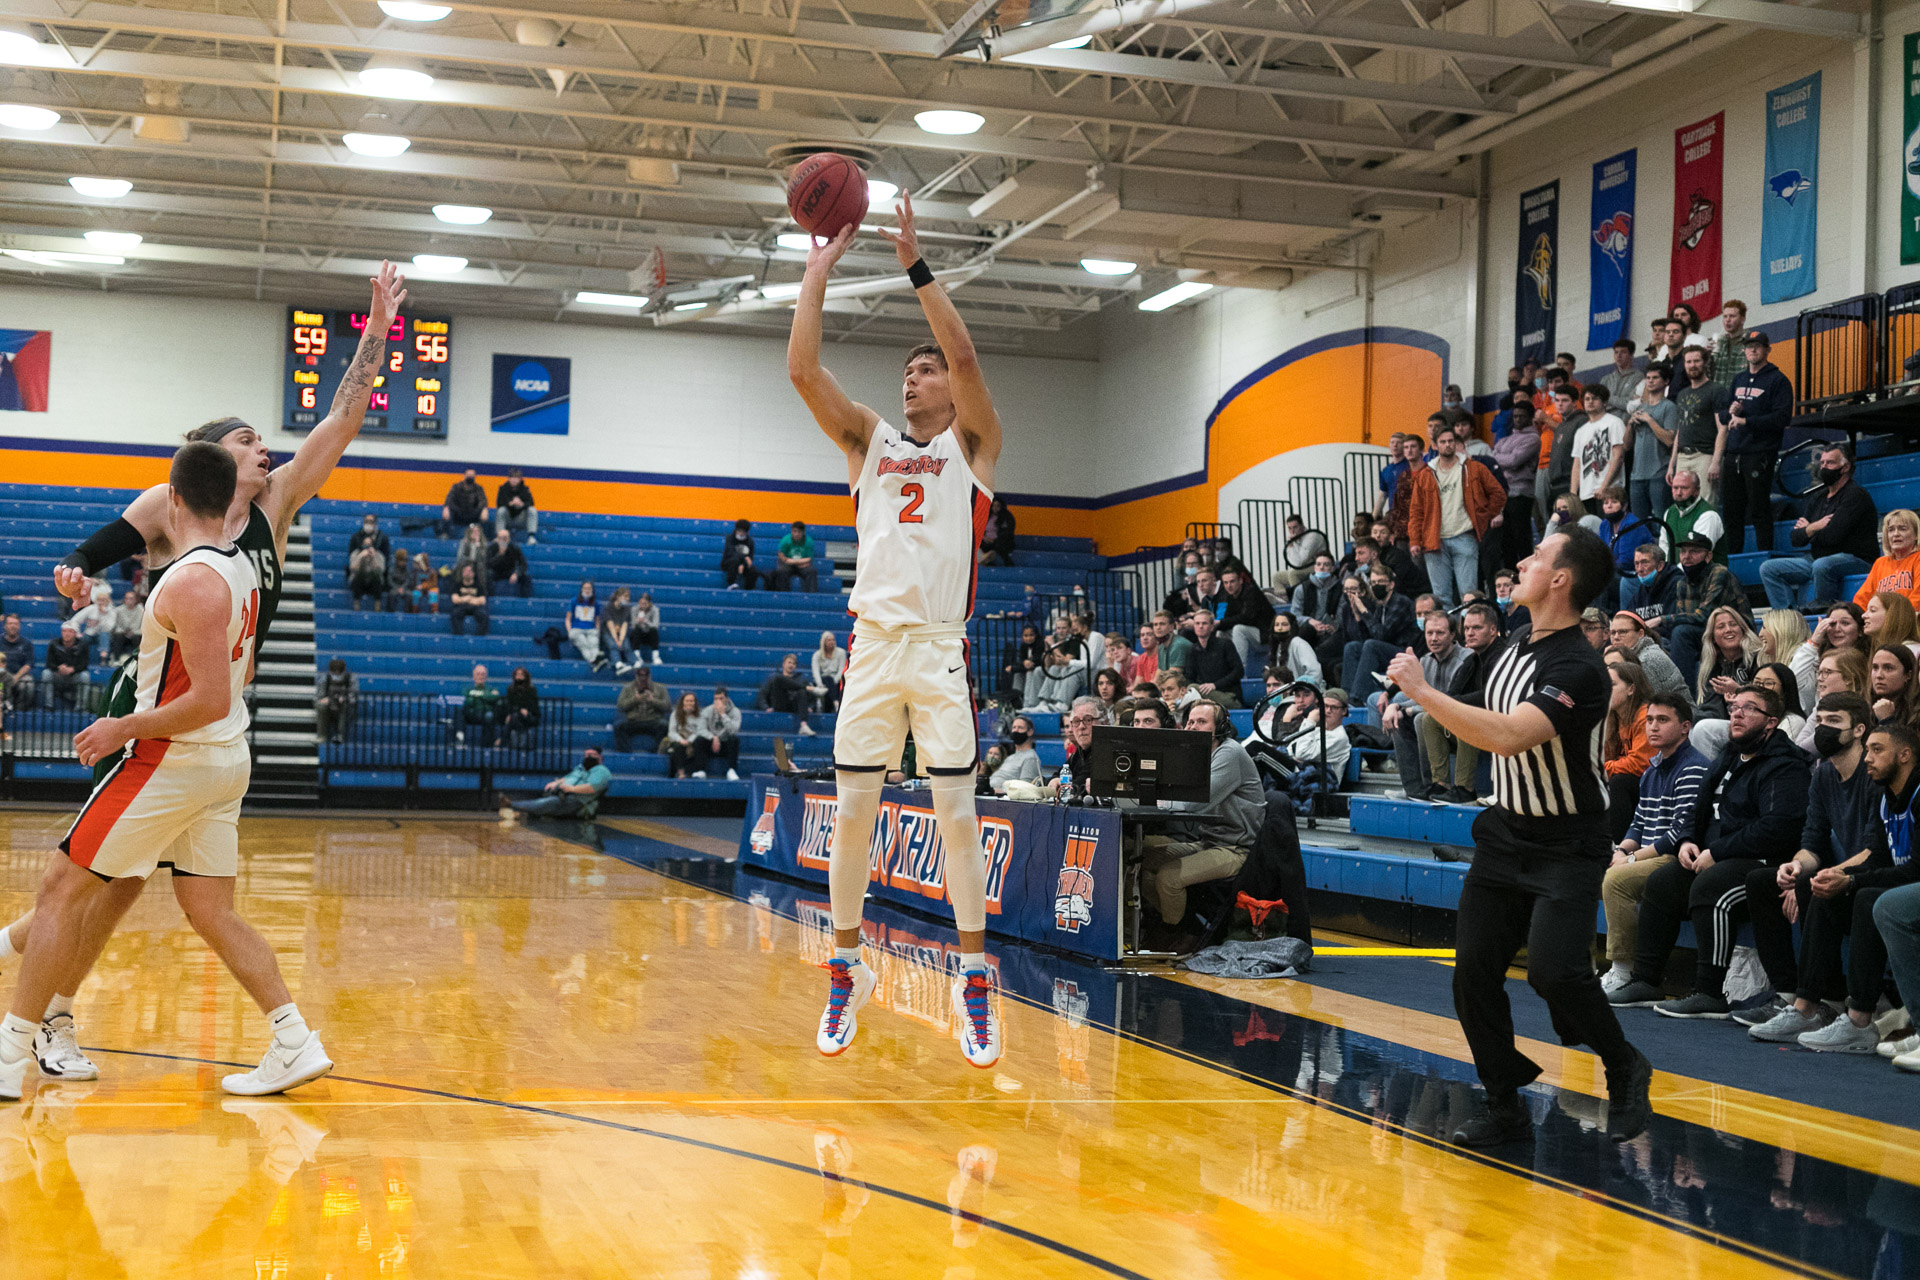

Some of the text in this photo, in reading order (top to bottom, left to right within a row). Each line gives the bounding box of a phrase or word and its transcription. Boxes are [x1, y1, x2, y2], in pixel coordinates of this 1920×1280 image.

[801, 180, 830, 217] NCAA
[294, 311, 323, 326] Home
[294, 327, 327, 355] 59
[416, 335, 448, 362] 56
[389, 351, 404, 372] 2
[514, 379, 550, 392] NCAA
[302, 387, 316, 409] 6
[417, 395, 436, 415] 10
[899, 483, 924, 523] 2
[1069, 825, 1100, 836] WHATON
[892, 808, 1012, 903] THUER
